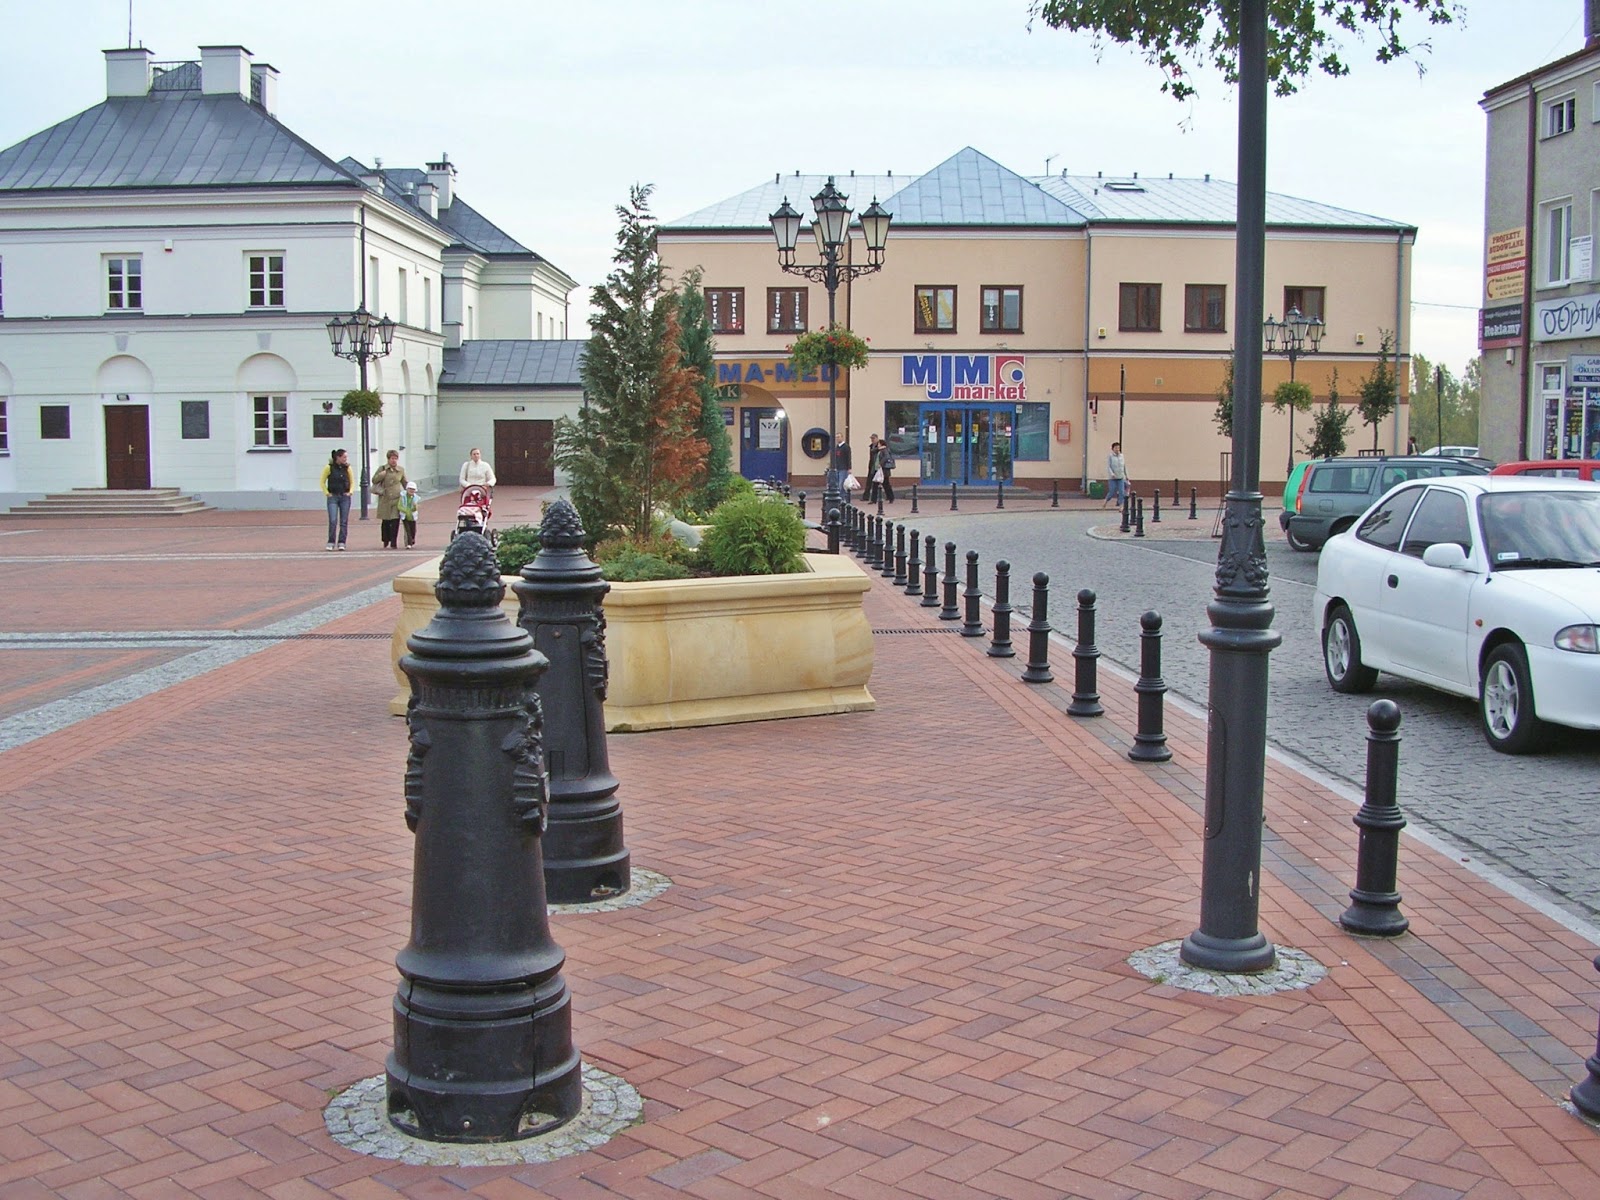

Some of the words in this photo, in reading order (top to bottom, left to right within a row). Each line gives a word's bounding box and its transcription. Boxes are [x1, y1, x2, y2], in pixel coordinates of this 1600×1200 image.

[1492, 230, 1520, 244] PROJEKTY
[1489, 240, 1524, 254] BUDOWLANE
[1484, 323, 1520, 337] Reklamy
[709, 362, 840, 383] MA-MED
[902, 355, 990, 400] MJM
[714, 385, 738, 398] YK
[954, 383, 1026, 400] market
